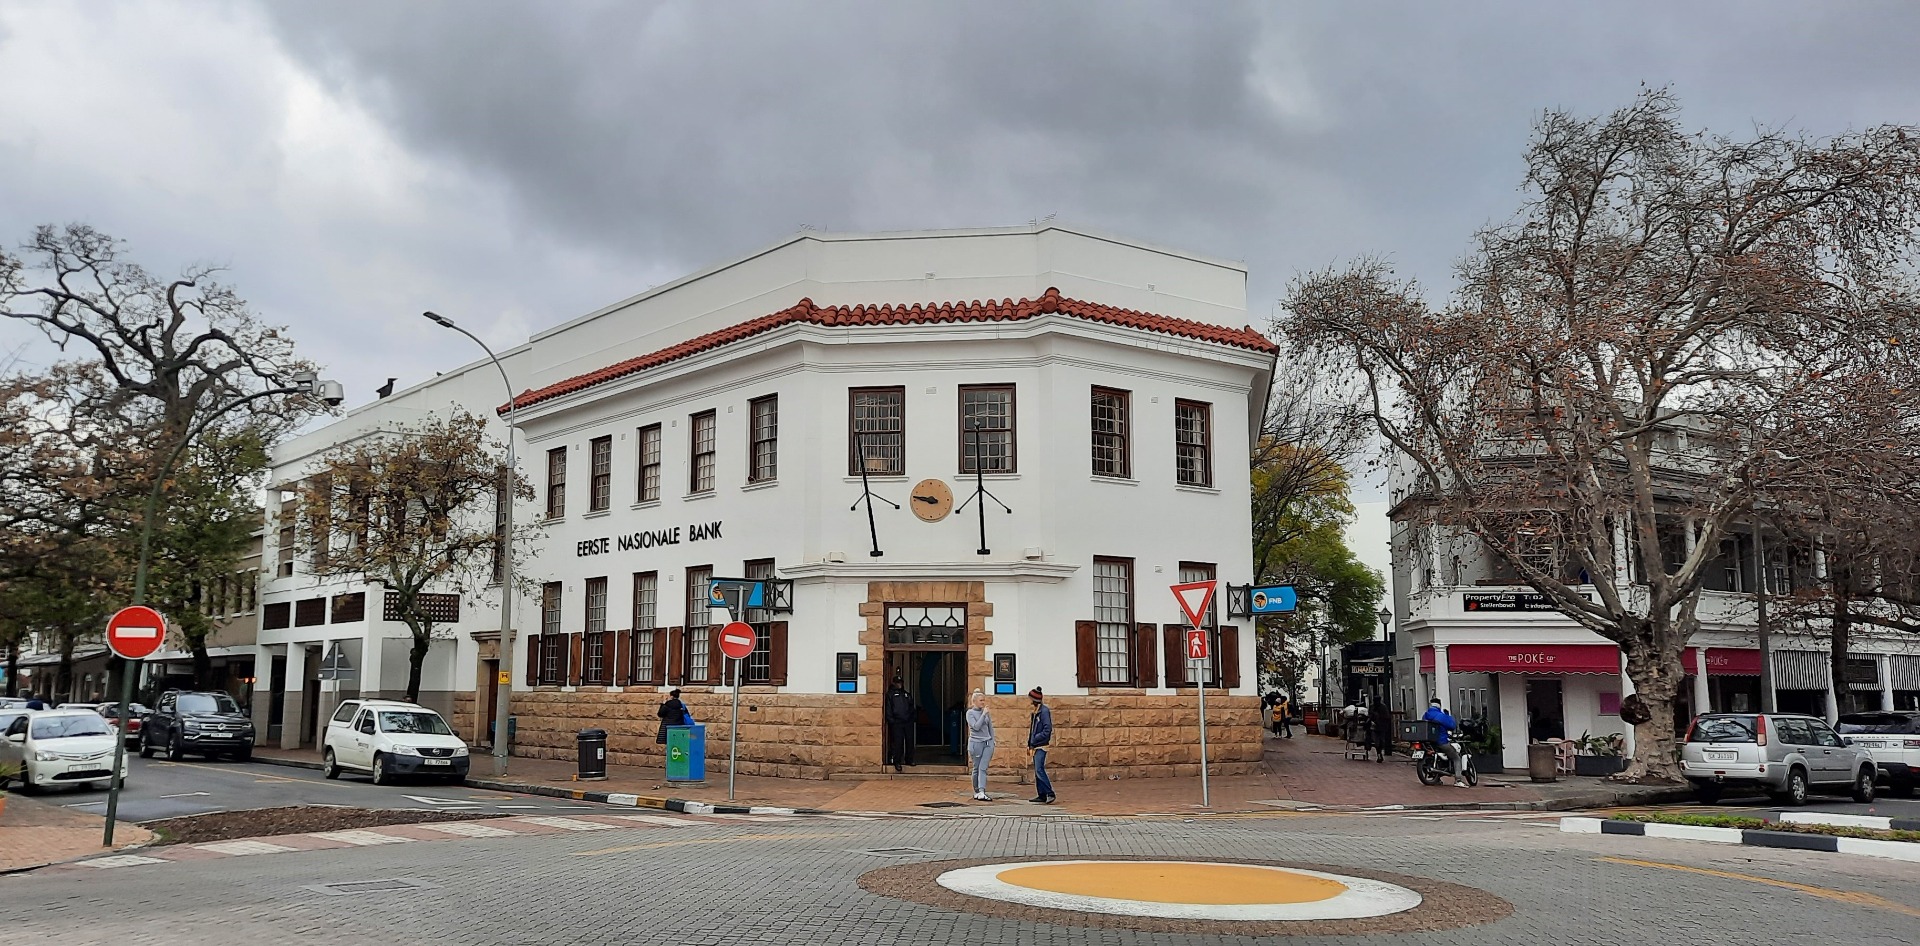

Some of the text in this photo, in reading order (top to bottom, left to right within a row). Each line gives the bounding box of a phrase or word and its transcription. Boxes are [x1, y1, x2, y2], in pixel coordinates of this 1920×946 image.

[577, 520, 723, 557] EERSTE NASIONALE BANK
